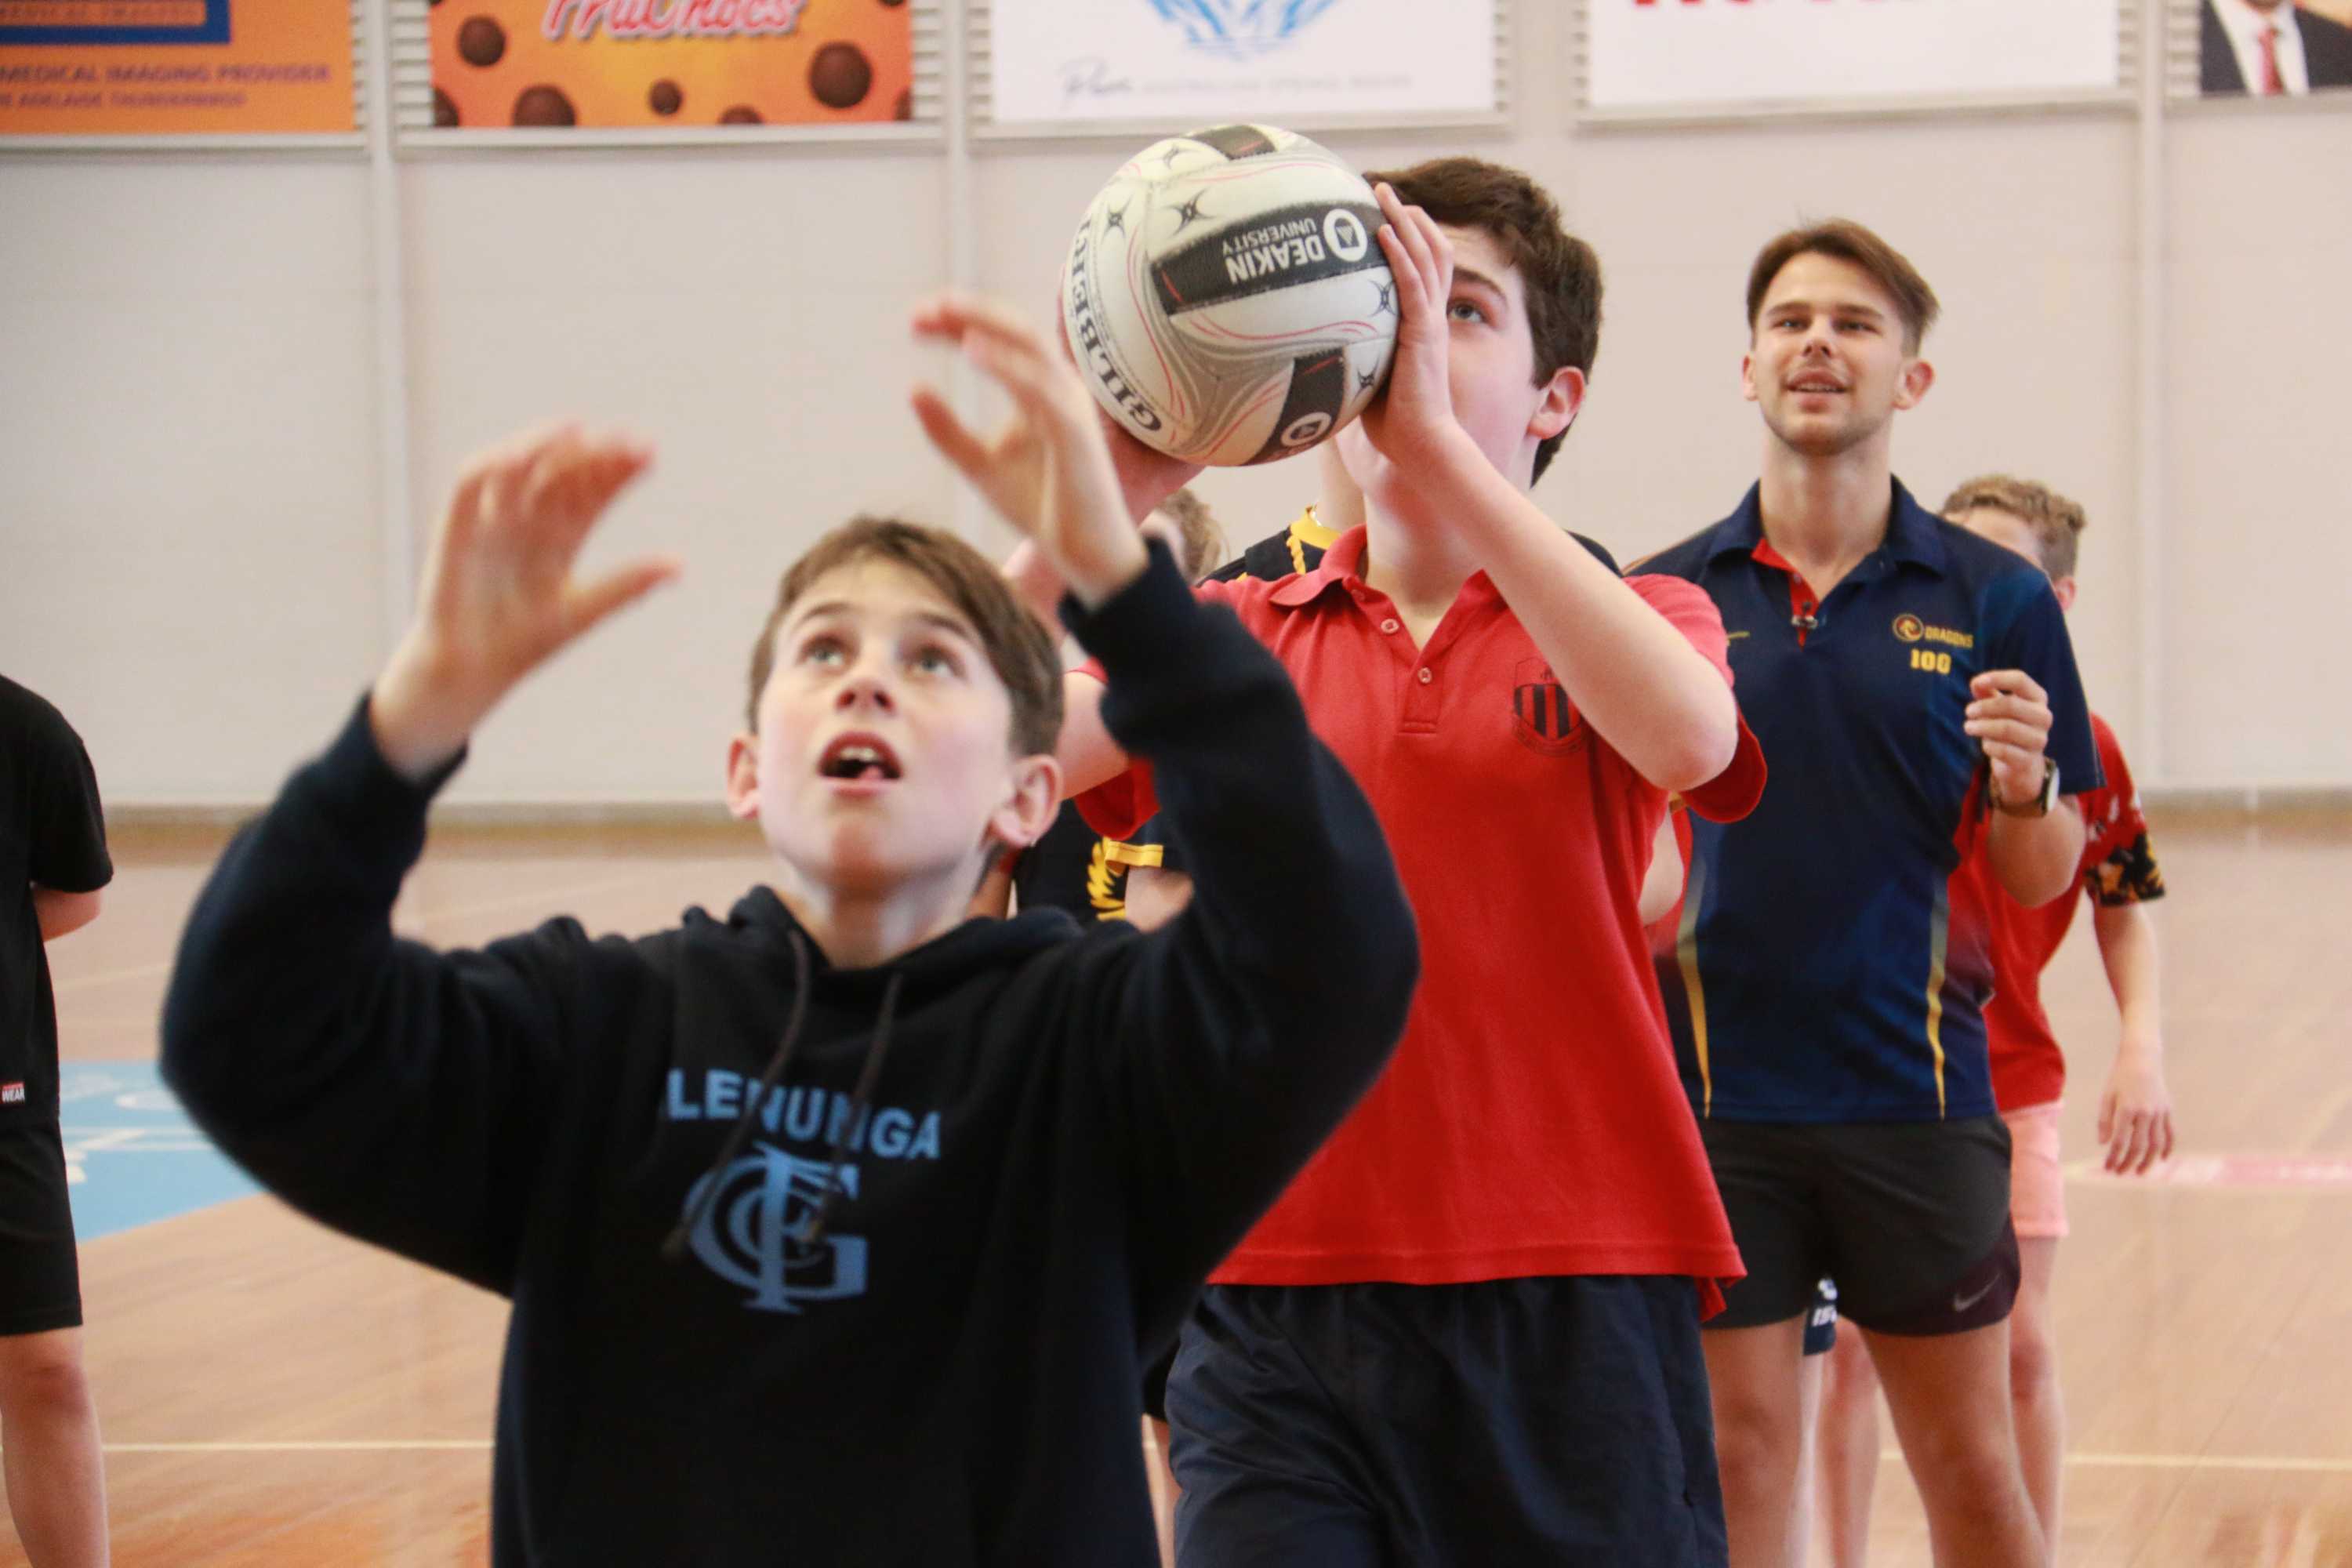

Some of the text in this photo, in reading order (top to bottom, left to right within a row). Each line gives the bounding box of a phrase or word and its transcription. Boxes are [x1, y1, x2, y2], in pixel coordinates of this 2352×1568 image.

[1222, 217, 1317, 256] UNIVERSITY
[1225, 234, 1326, 284] DEAKIN
[1924, 625, 1974, 648] DRAGONS
[1910, 648, 1952, 675] 100
